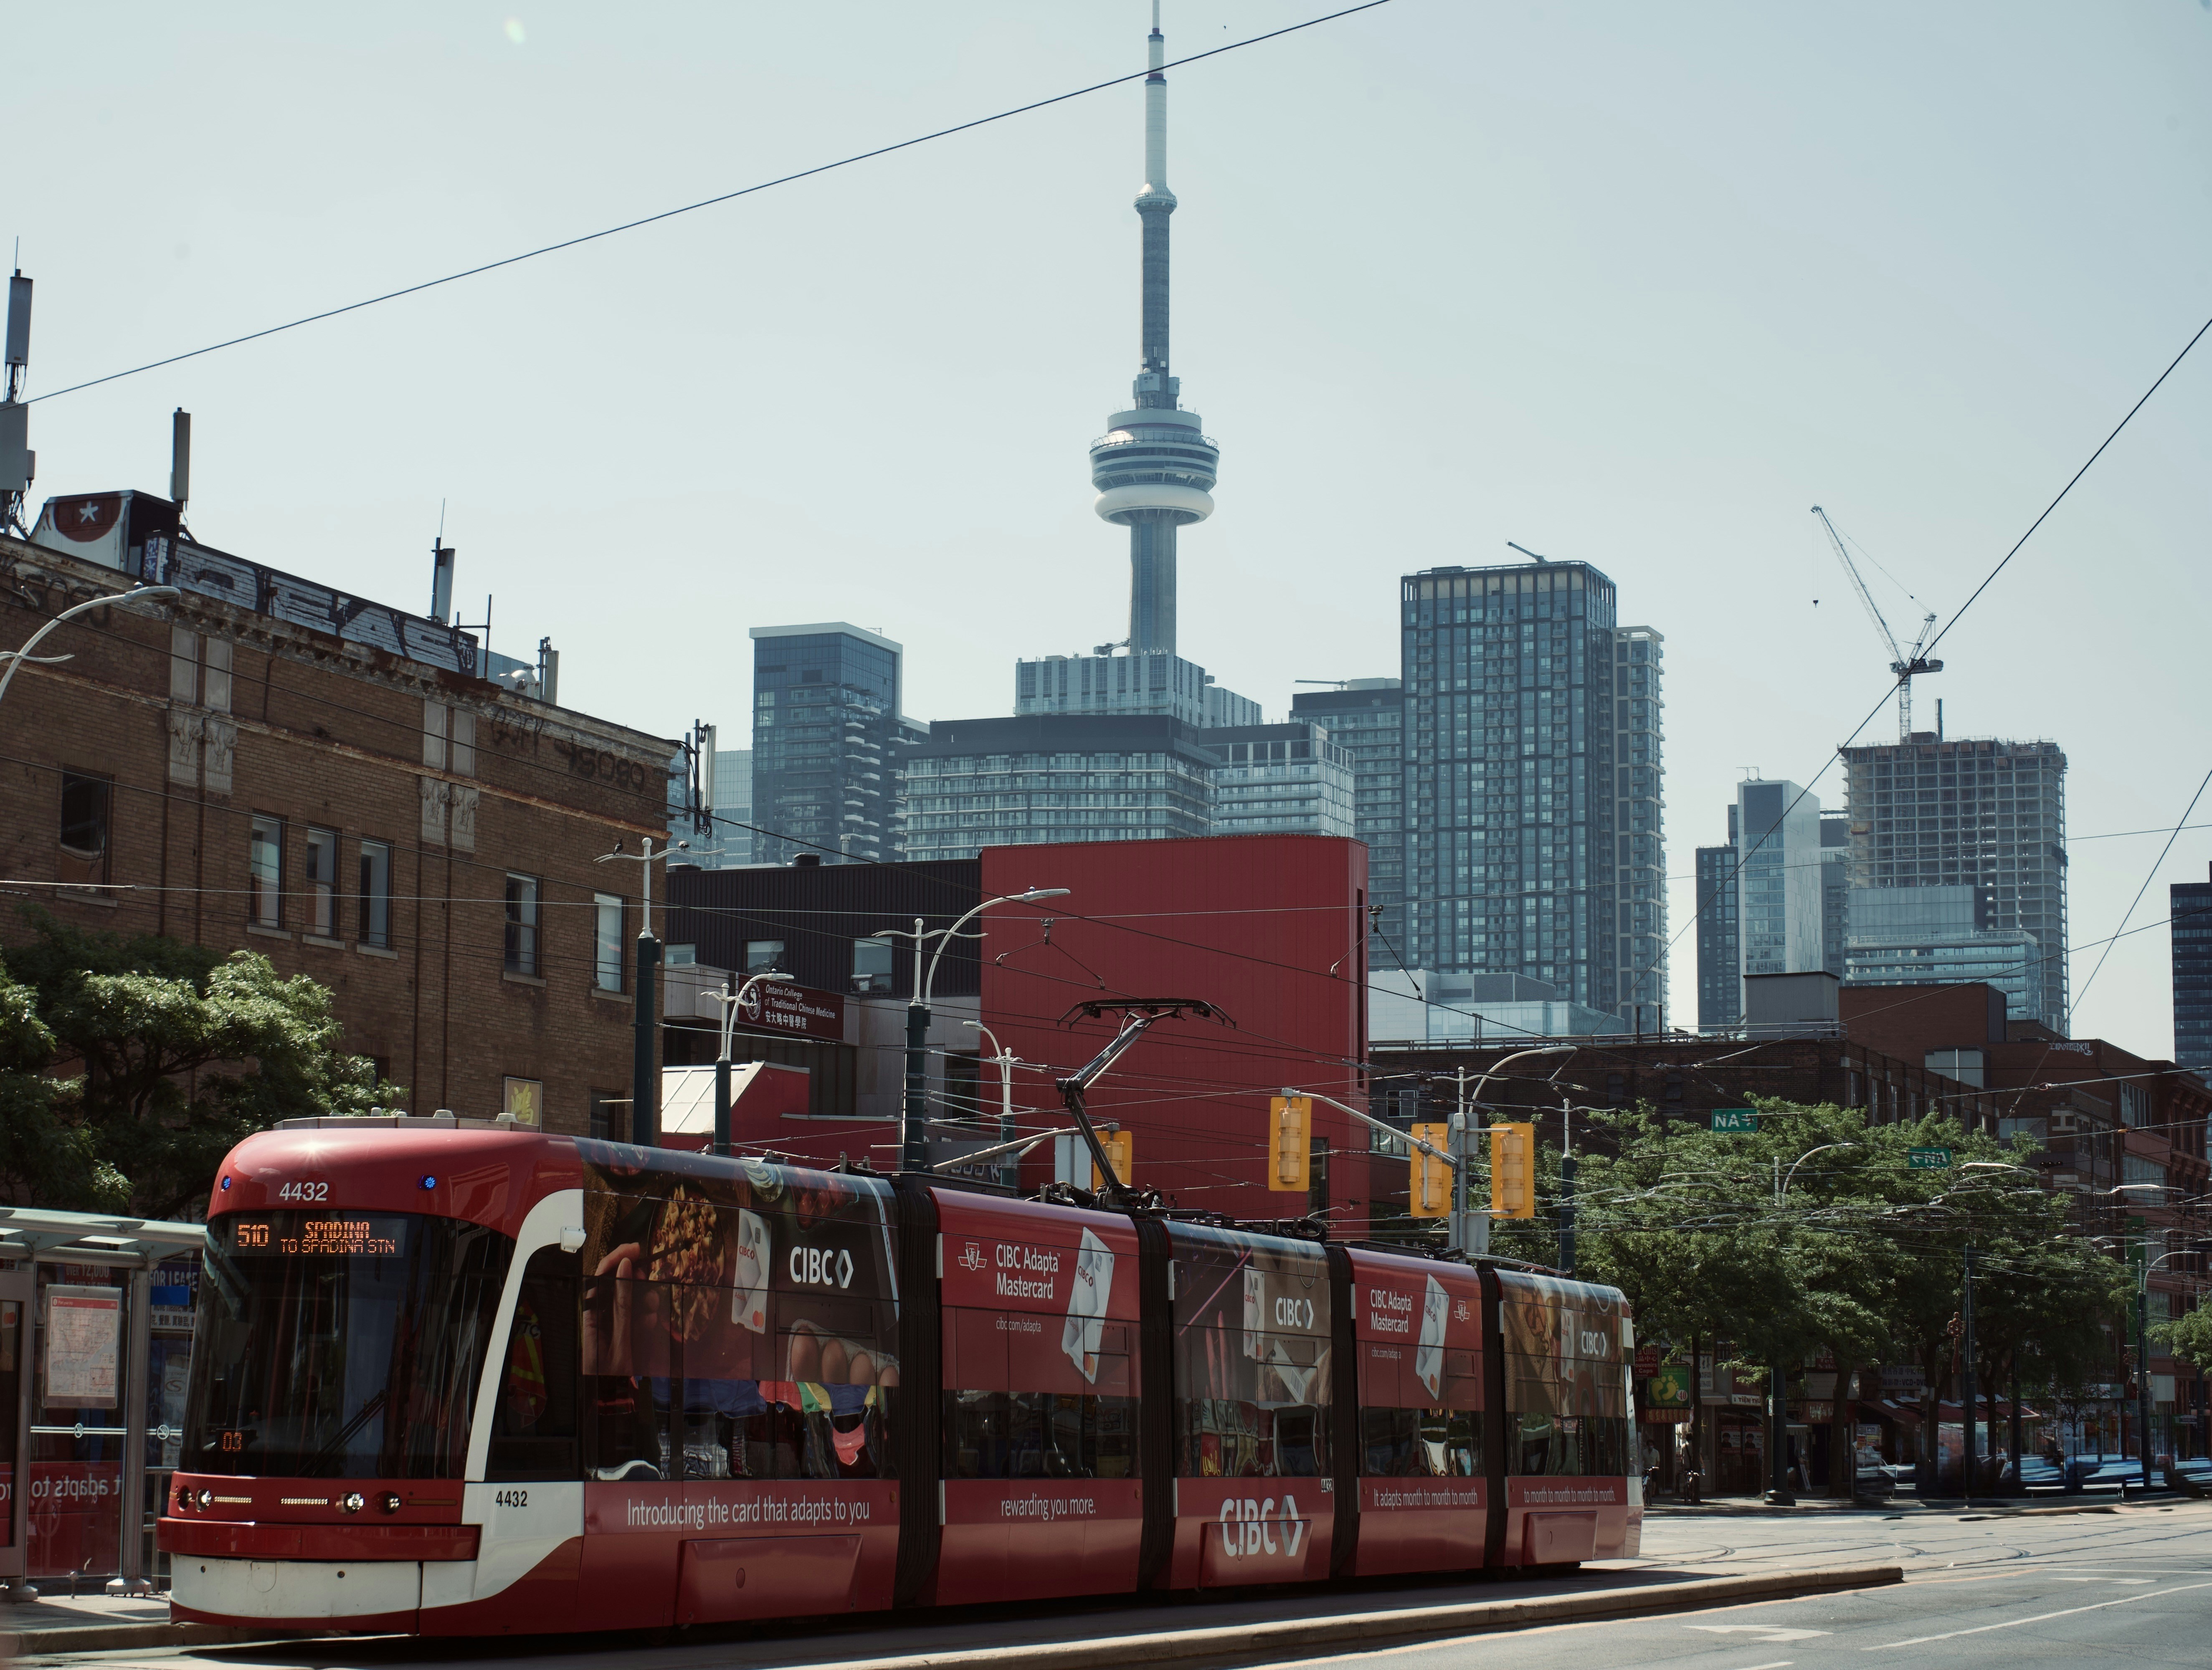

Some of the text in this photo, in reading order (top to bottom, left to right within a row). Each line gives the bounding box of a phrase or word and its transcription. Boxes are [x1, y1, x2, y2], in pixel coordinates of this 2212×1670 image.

[765, 984, 803, 1001] Ontario College
[765, 997, 835, 1019] of Traditional Chinese Medicine
[765, 1010, 807, 1030] 安大略中醫學院
[1715, 1113, 1740, 1127] NA
[279, 1182, 329, 1201] 4432
[238, 1224, 269, 1247] 510
[305, 1221, 370, 1239] SPADINA
[281, 1239, 395, 1253] TO SPADINA STN
[739, 1245, 750, 1258] CIBC
[790, 1246, 834, 1285] CIBC
[996, 1244, 1021, 1269] CIBC
[1078, 1265, 1088, 1283] CIBC
[996, 1272, 1053, 1299] Mastercard
[1370, 1289, 1387, 1309] CIBC
[1275, 1297, 1302, 1327] CIBC
[1371, 1311, 1409, 1333] Mastercard
[996, 1317, 1041, 1335] cibccom/adapta
[1581, 1330, 1599, 1355] CIBC
[1371, 1346, 1401, 1361] cibc.com/adapa
[1677, 1391, 1688, 1400] $40
[223, 1432, 242, 1452] 03
[1322, 1479, 1332, 1492] 4432
[1524, 1485, 1616, 1503] to month to month to month to month.
[496, 1490, 527, 1508] 4432
[1001, 1492, 1096, 1520] rewarding you more.
[1374, 1487, 1477, 1511] It adapts month to month to month
[627, 1495, 870, 1530] Introducing the card that adapts to you
[1219, 1498, 1277, 1557] CIBC
